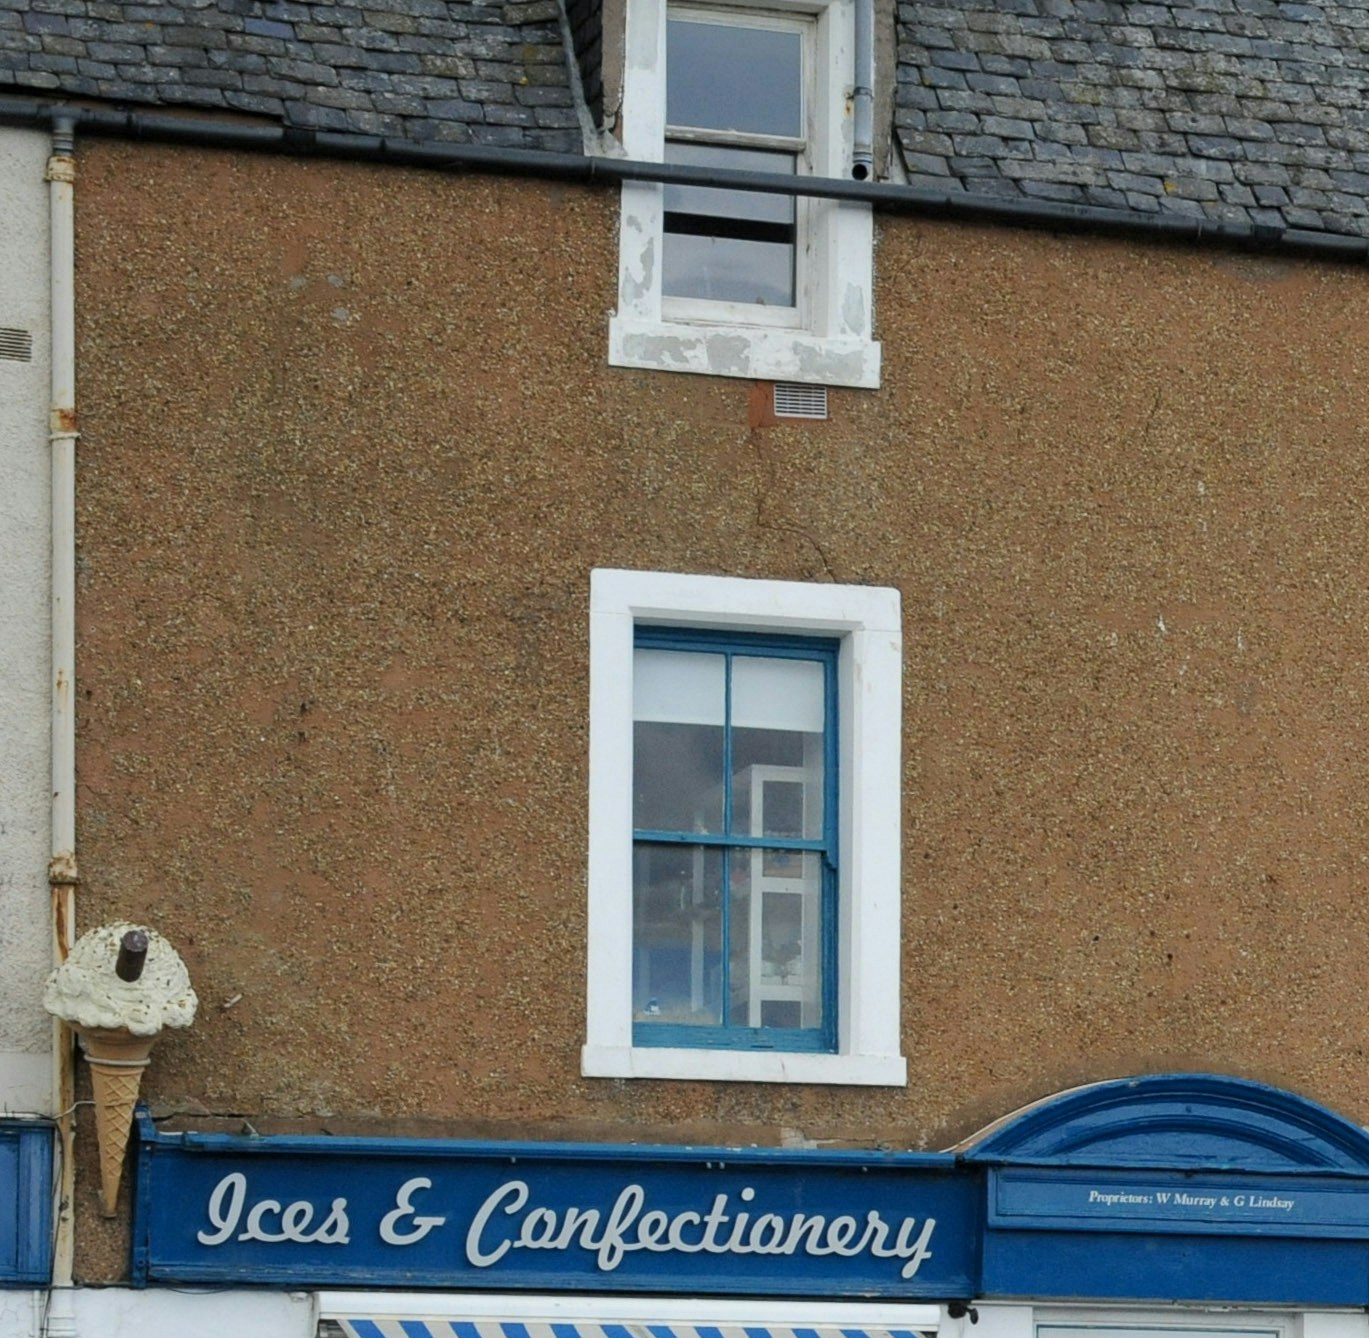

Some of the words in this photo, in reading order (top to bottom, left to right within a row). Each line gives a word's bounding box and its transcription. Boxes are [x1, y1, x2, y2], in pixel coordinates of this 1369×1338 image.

[197, 1172, 350, 1245] Ices
[379, 1177, 446, 1245] &
[466, 1180, 936, 1279] Confectionery
[1089, 1190, 1153, 1206] Proprietors:
[1156, 1192, 1171, 1204] W
[1174, 1193, 1216, 1209] Murray
[1220, 1196, 1230, 1207] &
[1234, 1195, 1245, 1207] G
[1250, 1195, 1295, 1211] Lindsay
